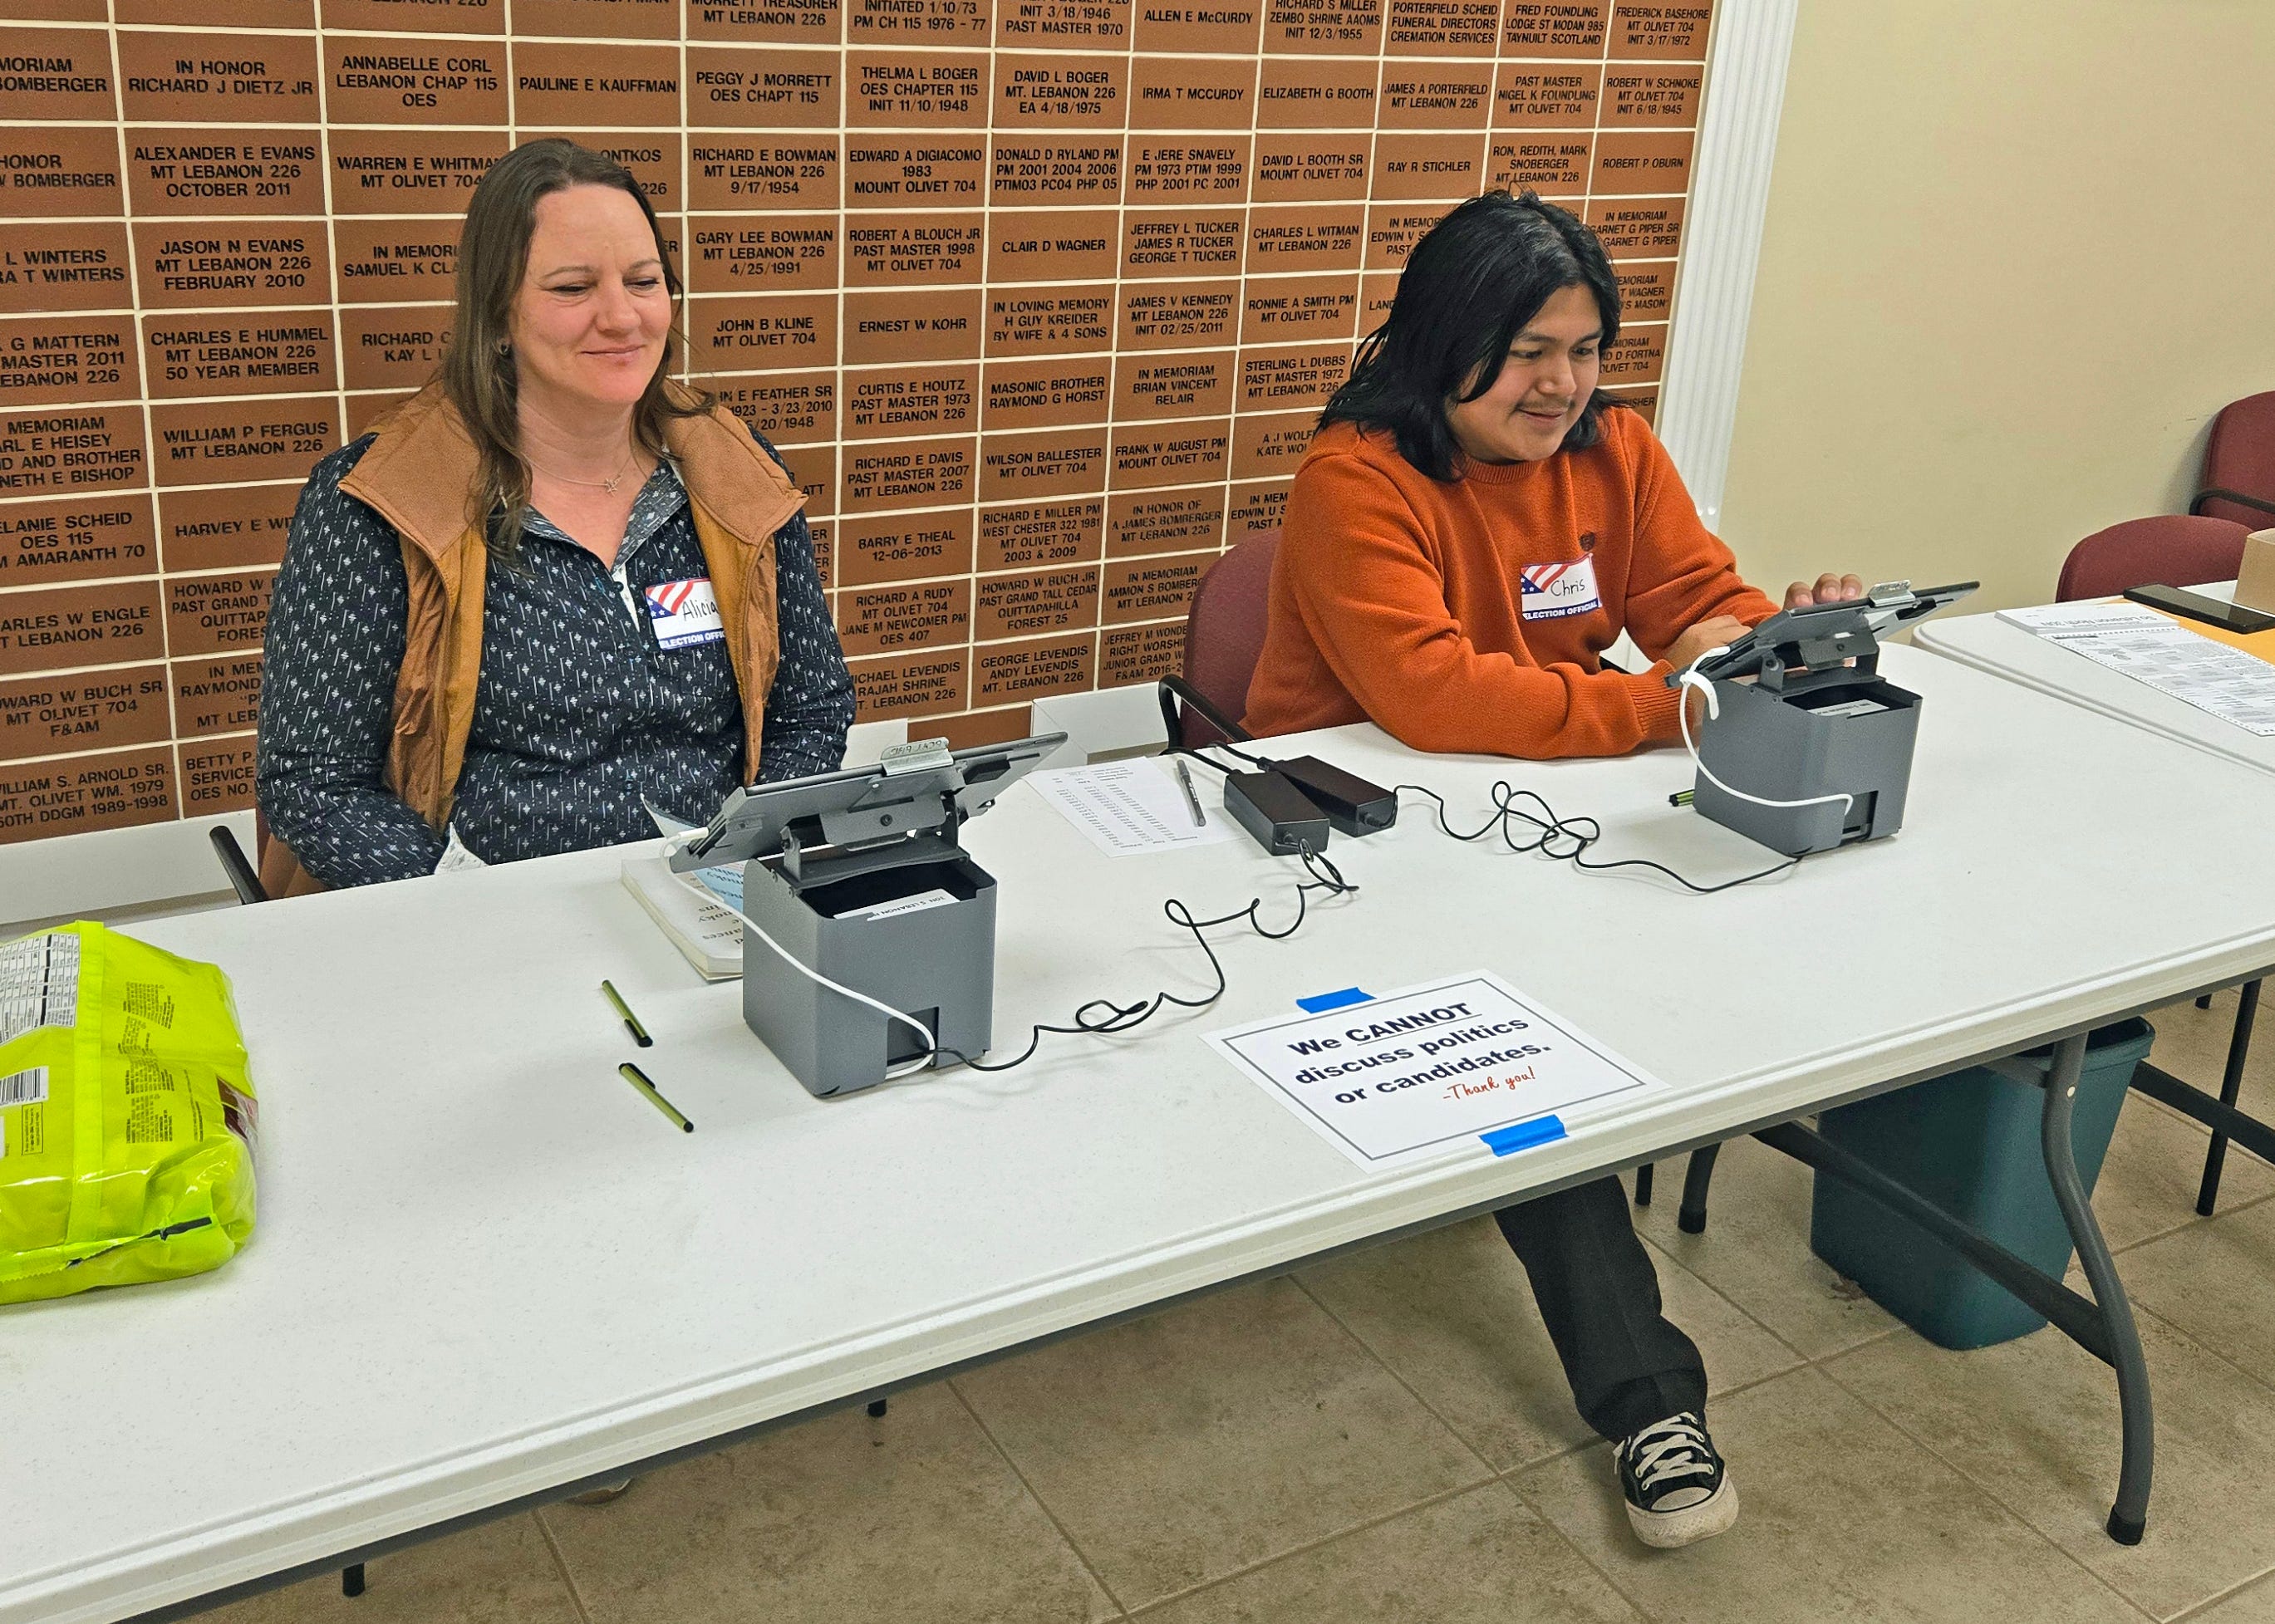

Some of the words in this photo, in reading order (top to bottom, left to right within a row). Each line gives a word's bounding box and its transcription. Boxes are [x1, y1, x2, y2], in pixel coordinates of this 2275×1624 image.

[1144, 9, 1182, 23] ALLEN
[1185, 10, 1192, 23] E
[1197, 10, 1253, 24] McCURDY
[1615, 7, 1662, 19] FREDERICK
[1664, 7, 1709, 20] BASEHORE
[1626, 20, 1641, 32] MT
[1643, 20, 1676, 33] OLIVET
[1678, 21, 1694, 33] 704
[1627, 34, 1645, 46] INIT
[1647, 34, 1691, 47] 3/17/1972
[175, 60, 194, 75] IN
[200, 60, 266, 76] HONOR
[341, 55, 440, 71] ANNABELLE
[446, 57, 492, 73] CORL
[128, 77, 209, 94] RICHARD
[216, 80, 226, 95] J
[233, 79, 285, 96] DIETZ
[291, 80, 313, 96] JR
[336, 73, 416, 90] LEBANON
[422, 75, 468, 91] CHAP
[474, 76, 498, 91] 115
[519, 76, 578, 91] PAULINE
[584, 77, 594, 91] E
[599, 78, 677, 93] KAUFFMAN
[695, 71, 744, 86] PEGGY
[749, 72, 759, 86] J
[764, 72, 832, 88] MORRETT
[710, 88, 741, 103] OES
[746, 88, 794, 103] CHAPT
[799, 90, 819, 103] 115
[1142, 86, 1172, 100] IRMA
[1176, 86, 1183, 99] T
[1187, 87, 1244, 101] MCCURDY
[1263, 86, 1322, 100] ELIZABETH
[1324, 87, 1334, 101] G
[1337, 87, 1374, 101] BOOTH
[1384, 83, 1416, 96] JAMES
[1418, 83, 1425, 95] A
[1427, 83, 1488, 96] PORTERFIELD
[401, 92, 437, 108] OES
[1391, 96, 1407, 108] MT
[1409, 96, 1457, 110] LEBANON
[1460, 97, 1478, 110] 226
[134, 145, 237, 161] ALEXANDER
[243, 145, 254, 161] E
[260, 145, 316, 161] EVANS
[1261, 154, 1294, 167] DAVID
[1296, 155, 1304, 166] L
[1307, 154, 1345, 166] BOOTH
[1348, 153, 1364, 165] SR
[150, 164, 176, 179] MT
[183, 164, 263, 179] LEBANON
[270, 164, 302, 179] 226
[1387, 161, 1408, 174] RAY
[1410, 160, 1418, 173] R
[1422, 160, 1471, 173] STICHLER
[1602, 157, 1640, 169] ROBERT
[1642, 157, 1649, 169] P
[1651, 157, 1684, 169] OBURN
[1260, 168, 1300, 181] MOUNT
[1303, 168, 1340, 180] OLIVET
[1344, 167, 1364, 179] 704
[165, 182, 248, 198] OCTOBER
[255, 182, 291, 197] 2011
[695, 231, 734, 245] GARY
[739, 231, 765, 244] LEE
[771, 229, 833, 243] BOWMAN
[1130, 223, 1179, 236] JEFFREY
[1183, 222, 1190, 234] L
[1195, 221, 1240, 234] TUCKER
[1001, 240, 1038, 253] CLAIR
[1042, 239, 1051, 253] D
[1055, 238, 1106, 252] WAGNER
[1133, 237, 1172, 250] JAMES
[1177, 237, 1185, 248] R
[1189, 235, 1234, 248] TUCKER
[703, 248, 725, 261] MT
[729, 246, 794, 260] LEBANON
[800, 245, 825, 258] 226
[1128, 251, 1177, 264] GEORGE
[1182, 250, 1188, 262] T
[1192, 249, 1237, 263] TUCKER
[730, 261, 801, 276] 4/25/1991
[858, 319, 910, 333] ERNEST
[914, 319, 927, 331] W
[931, 317, 967, 331] KOHR
[150, 330, 232, 346] CHARLES
[238, 329, 249, 344] E
[257, 327, 328, 343] HUMMEL
[165, 348, 191, 363] MT
[198, 346, 278, 362] LEBANON
[285, 345, 317, 359] 226
[166, 366, 189, 380] 50
[194, 364, 241, 380] YEAR
[247, 361, 320, 377] MEMBER
[857, 381, 904, 396] CURTIS
[909, 380, 917, 393] E
[922, 378, 966, 392] HOUTZ
[851, 397, 883, 411] PAST
[887, 395, 939, 409] MASTER
[945, 392, 970, 406] 1973
[855, 413, 874, 425] MT
[878, 409, 938, 424] LEBANON
[943, 407, 966, 421] 226
[163, 426, 236, 444] WILLIAM
[243, 424, 254, 439] P
[260, 421, 329, 438] FERGUS
[170, 445, 196, 460] MT
[204, 440, 285, 459] LEBANON
[292, 438, 323, 454] 226
[985, 452, 1033, 466] WILSON
[1037, 447, 1102, 464] BALLESTER
[999, 467, 1017, 478] MT
[1021, 463, 1062, 478] OLIVET
[1066, 462, 1087, 473] 704
[20, 533, 59, 550] OES
[67, 531, 94, 546] 115
[857, 535, 899, 549] BARRY
[904, 533, 911, 546] E
[917, 530, 956, 543] THEAL
[872, 544, 942, 562] 12-06-2013
[1550, 578, 1586, 597] Chris
[682, 599, 720, 621] Alicia
[1522, 609, 1565, 621] ELECTION
[1566, 601, 1597, 615] OFFICIAL
[980, 652, 1029, 669] GEORGE
[1034, 645, 1088, 663] LEVENDIS
[990, 666, 1020, 680] ANDY
[1024, 659, 1079, 676] LEVENDIS
[982, 682, 1001, 694] MT.
[1006, 674, 1059, 691] LEBANON
[1064, 670, 1084, 684] 226
[6, 710, 31, 726] MT
[39, 703, 99, 723] OLIVET
[106, 699, 139, 714] 704
[50, 719, 100, 737] F&AM
[1287, 1038, 1343, 1057] We
[1344, 1002, 1473, 1043] CANNOT
[1295, 1048, 1415, 1085] discuss
[1418, 1018, 1530, 1057] politics
[1334, 1087, 1368, 1104] or
[1375, 1043, 1552, 1094] candidates.
[1505, 1065, 1536, 1092] you!
